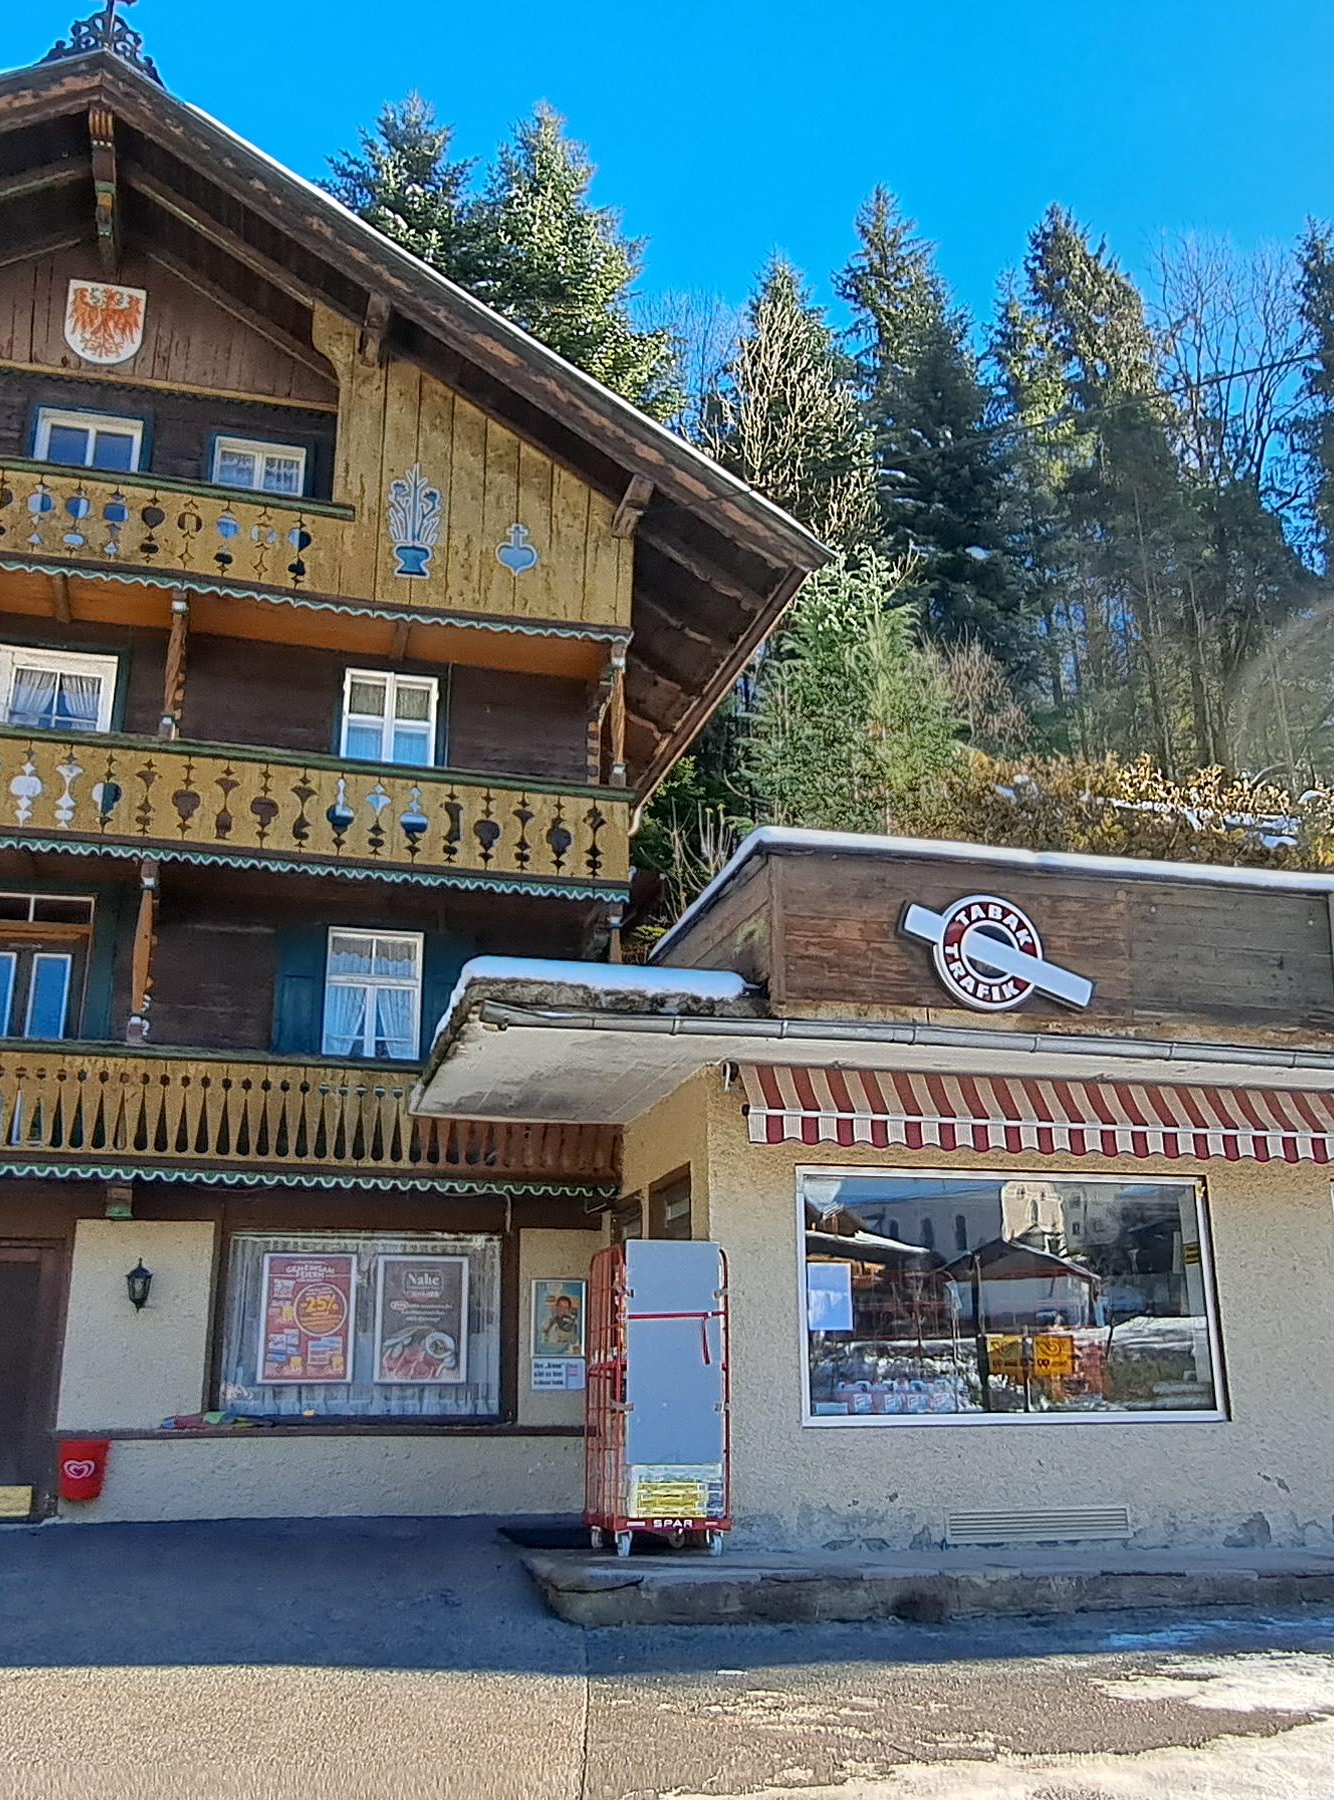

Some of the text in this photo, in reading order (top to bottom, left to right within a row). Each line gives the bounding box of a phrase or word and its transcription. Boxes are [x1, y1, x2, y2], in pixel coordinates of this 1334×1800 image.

[955, 904, 1033, 944] TABAK
[945, 942, 1021, 1001] TRAFIK
[408, 1271, 441, 1286] Nahe
[653, 1519, 693, 1528] SPAR
